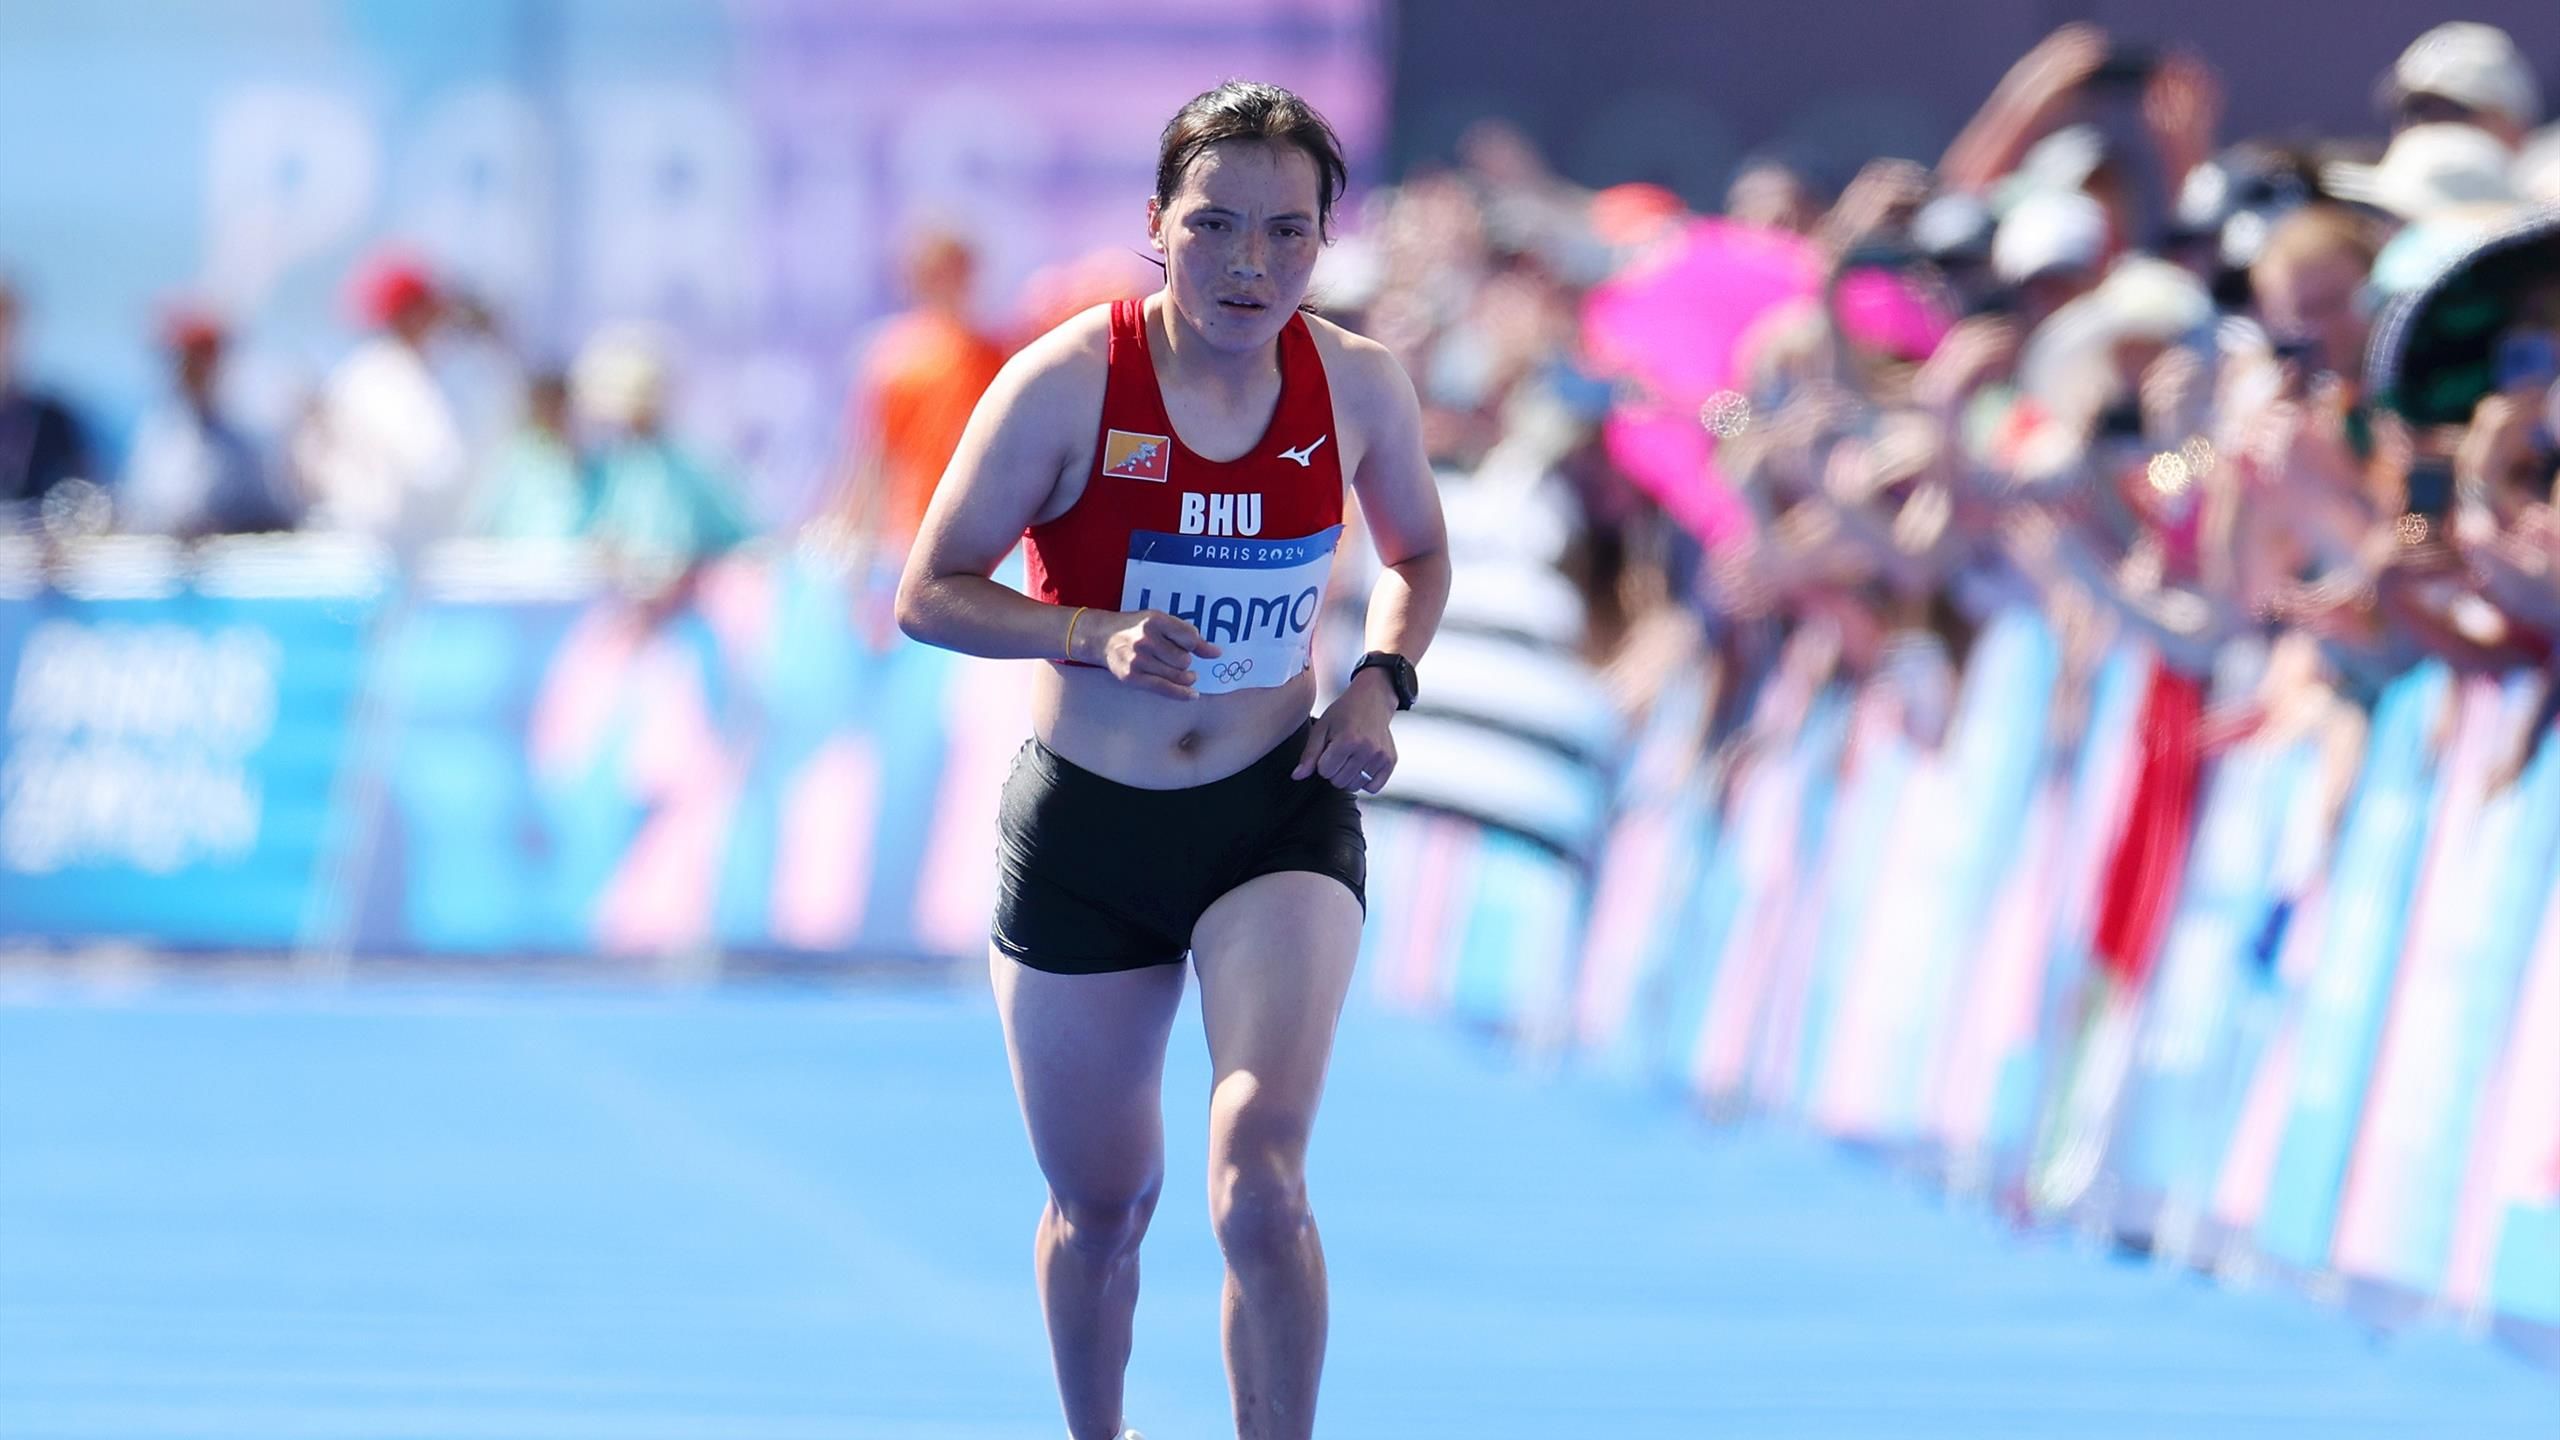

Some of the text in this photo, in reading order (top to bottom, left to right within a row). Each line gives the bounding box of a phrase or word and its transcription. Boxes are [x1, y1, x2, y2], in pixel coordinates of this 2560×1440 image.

[1180, 492, 1262, 536] BHU
[1193, 545, 1304, 561] PARIS 2024
